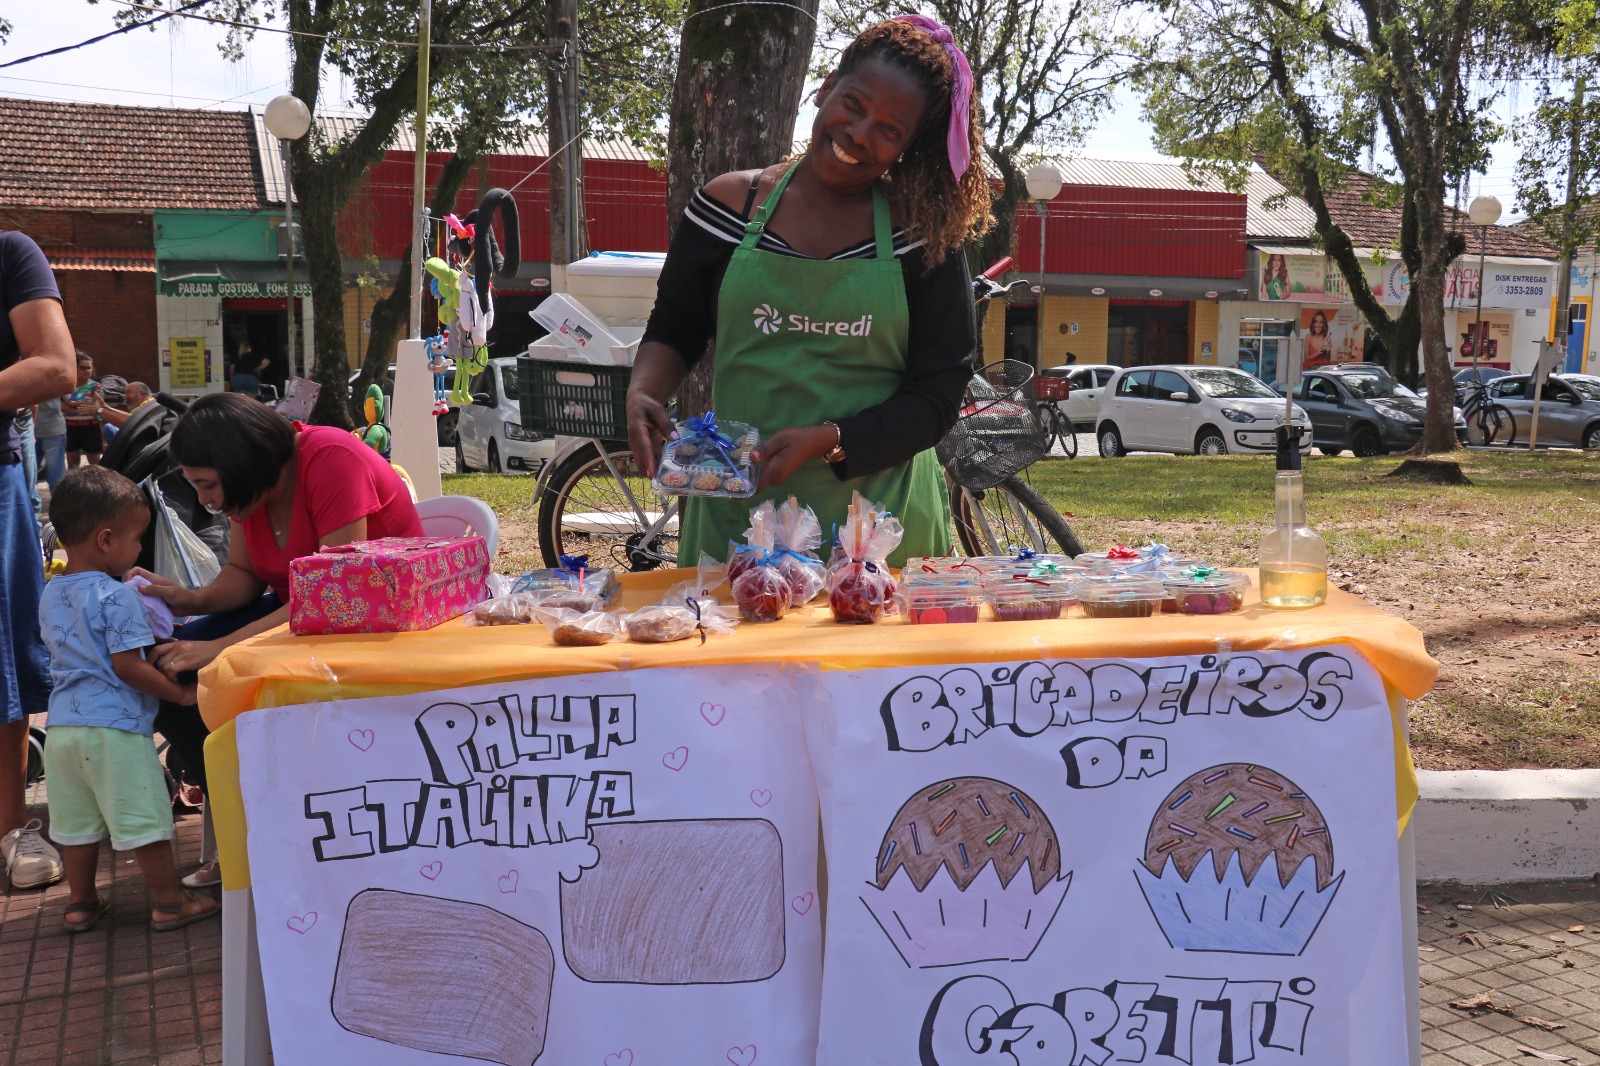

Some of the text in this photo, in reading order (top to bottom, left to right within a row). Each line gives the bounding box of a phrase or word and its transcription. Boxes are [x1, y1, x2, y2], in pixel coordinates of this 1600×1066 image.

[1445, 268, 1480, 279] MACIA
[1512, 275, 1547, 284] ENTREGAS
[178, 283, 214, 294] PARADA
[218, 282, 259, 294] GOSTOSA
[266, 283, 288, 293] FONE
[1504, 285, 1544, 295] 3353-2809
[787, 314, 873, 337] Sicredi
[415, 694, 636, 785] PALHA
[1060, 735, 1168, 789] DA
